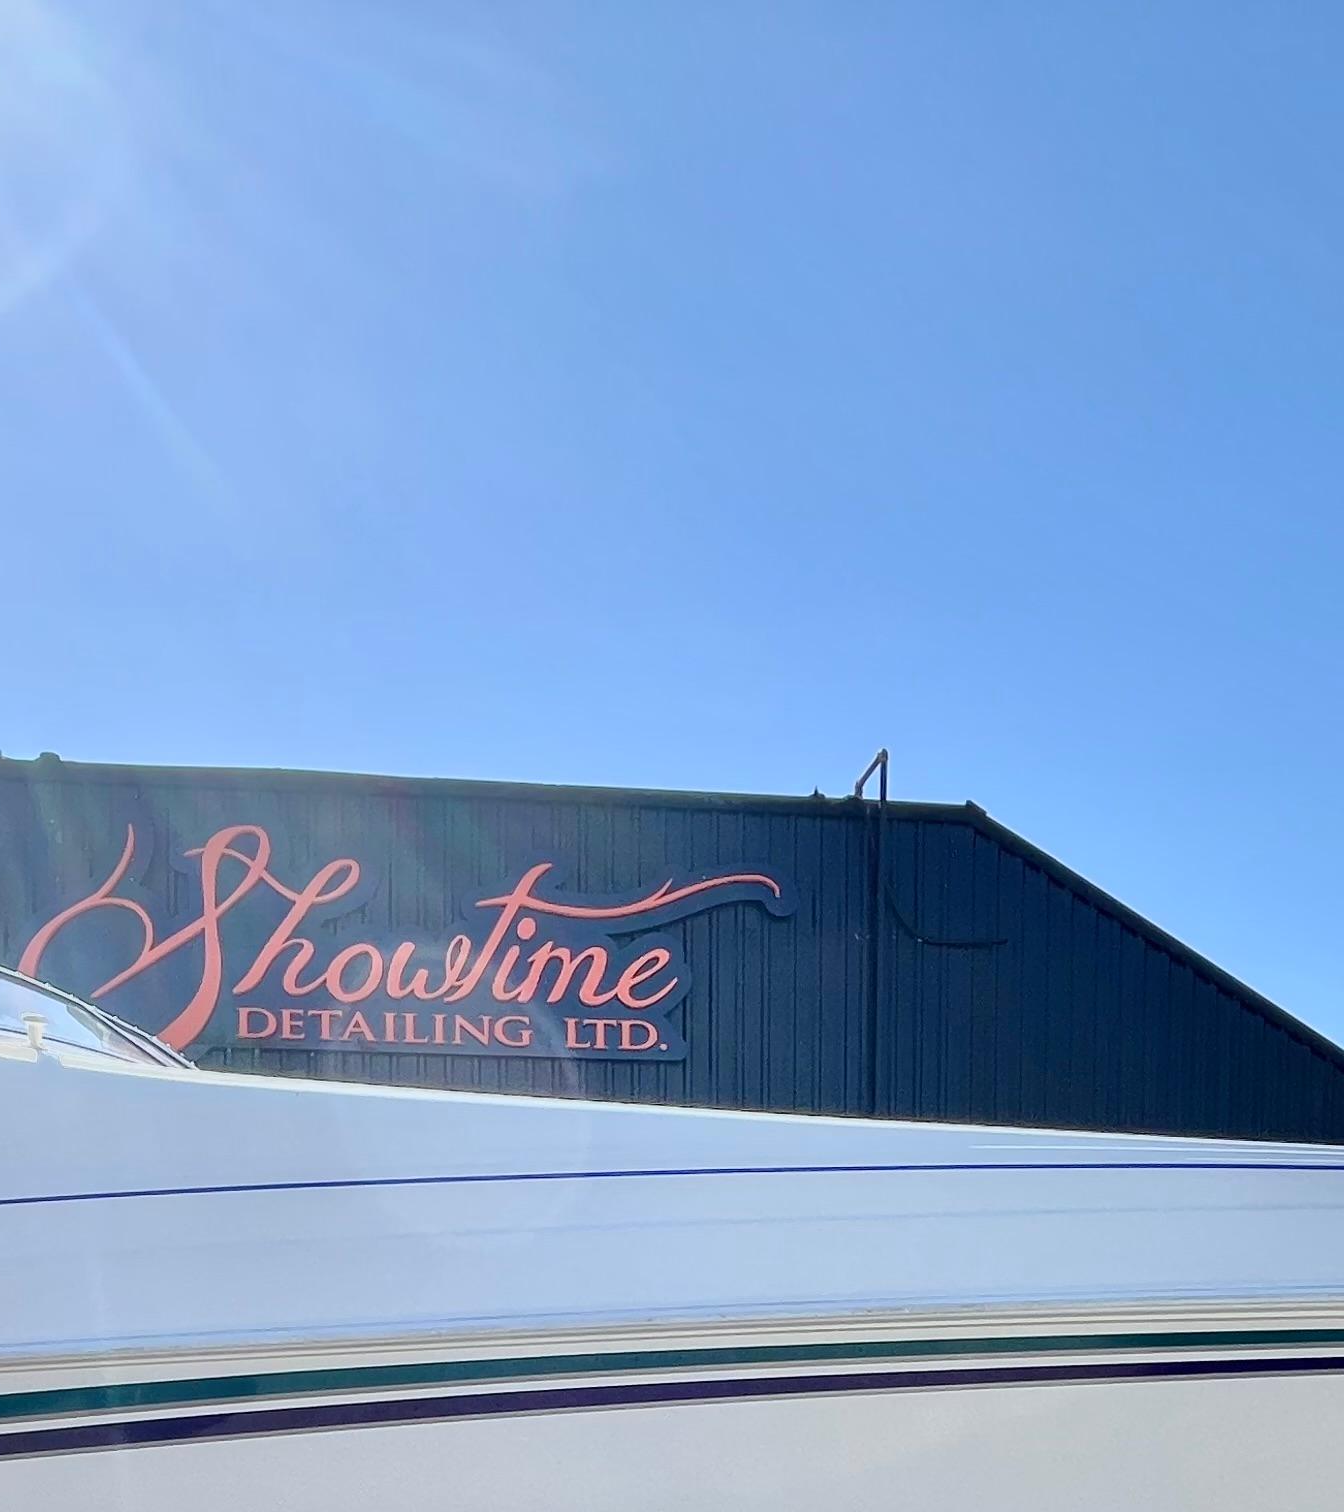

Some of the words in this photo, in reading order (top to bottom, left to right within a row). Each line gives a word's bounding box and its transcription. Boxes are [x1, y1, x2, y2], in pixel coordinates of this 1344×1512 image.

[18, 822, 781, 1052] Showtime
[236, 1005, 533, 1047] DETAILING
[563, 1017, 669, 1052] LTD.
